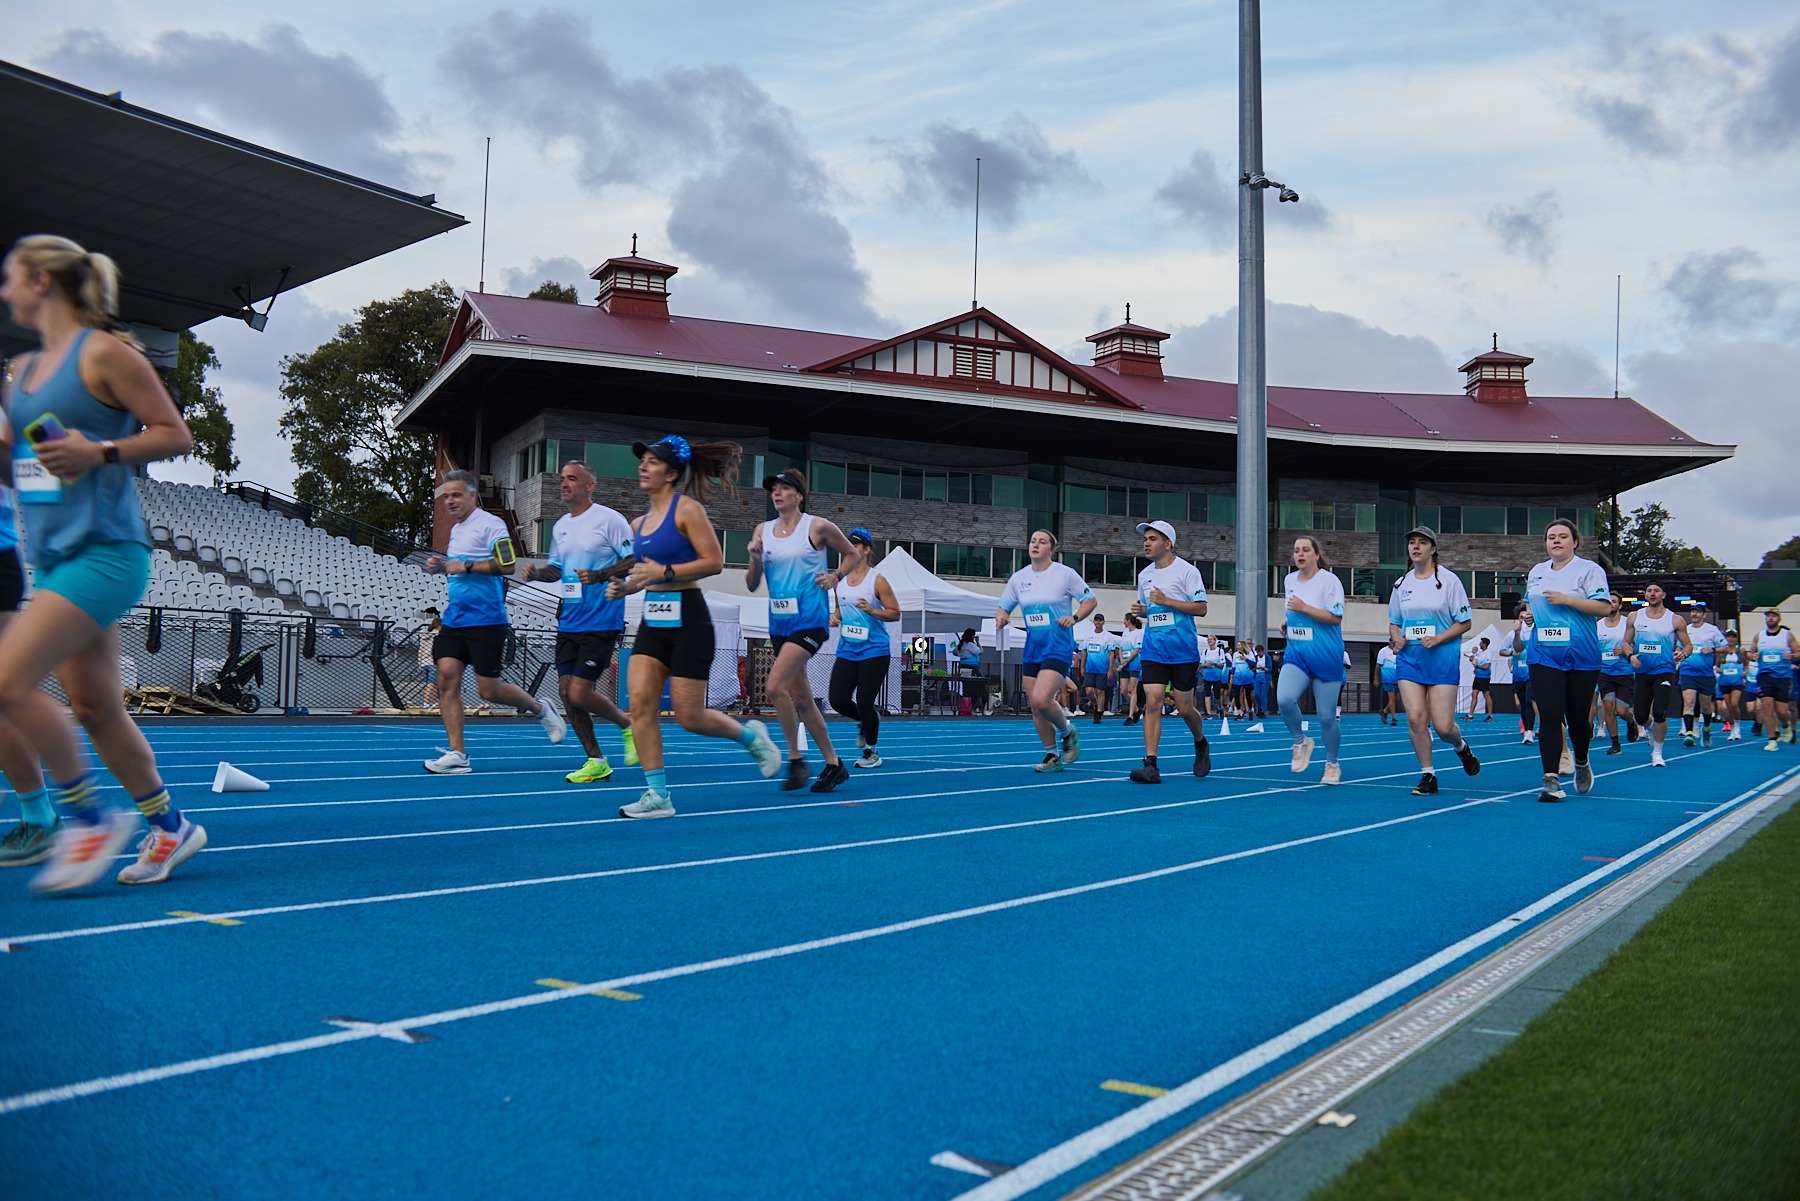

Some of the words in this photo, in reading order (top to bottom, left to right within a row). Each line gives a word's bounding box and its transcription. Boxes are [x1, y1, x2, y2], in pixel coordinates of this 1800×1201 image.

[648, 603, 672, 613] 2044
[1029, 614, 1044, 622] 1203
[1152, 614, 1167, 622] 1762
[1412, 627, 1427, 635] 1617
[1544, 629, 1562, 637] 1674
